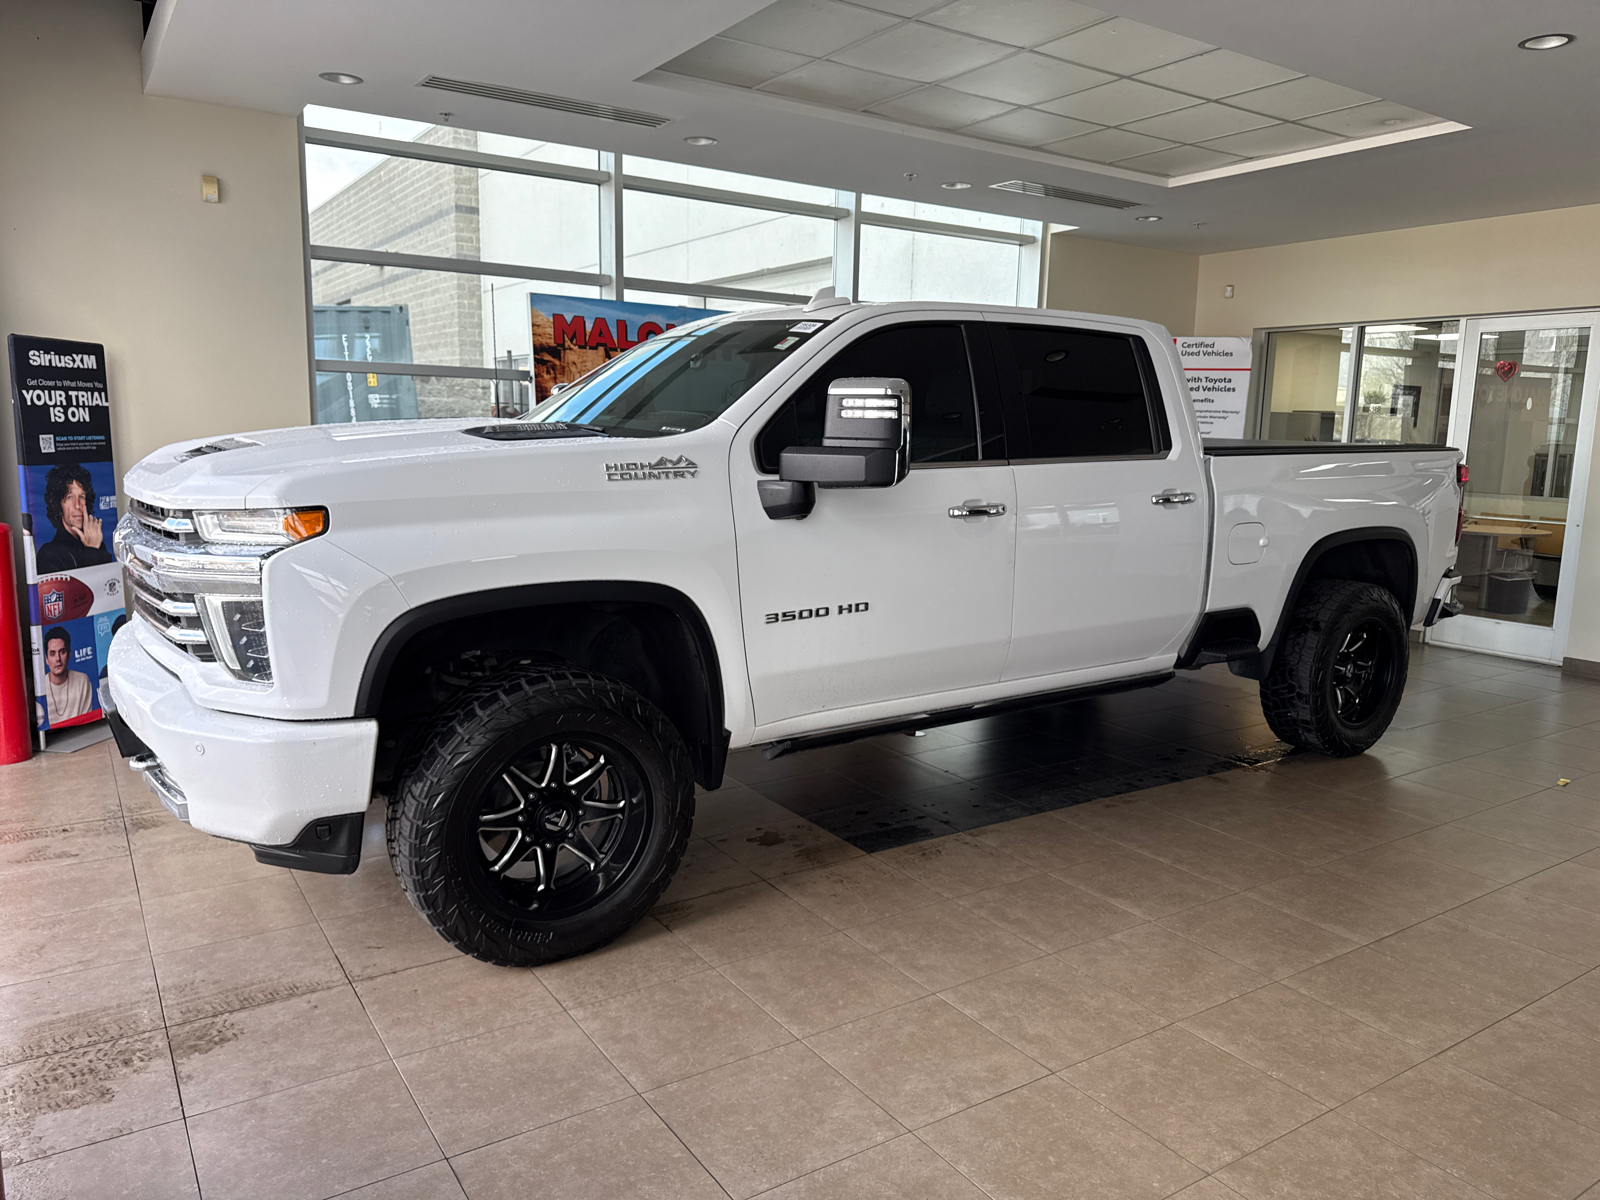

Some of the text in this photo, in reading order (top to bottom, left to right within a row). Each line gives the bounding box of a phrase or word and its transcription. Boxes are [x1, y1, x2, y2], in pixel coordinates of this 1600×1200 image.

[553, 313, 678, 349] MALO
[28, 349, 97, 369] SiriusXM
[26, 378, 103, 389] Get Closer to What Moves You
[1204, 376, 1232, 385] Toyota
[1202, 385, 1236, 393] Vehicles
[21, 389, 109, 407] YOUR TRIAL
[50, 406, 90, 422] IS ON
[603, 461, 652, 472] HIGH
[605, 469, 698, 481] COUNTRY
[45, 602, 63, 617] NFL
[764, 601, 869, 625] 3500 HD
[74, 646, 93, 659] LIFE
